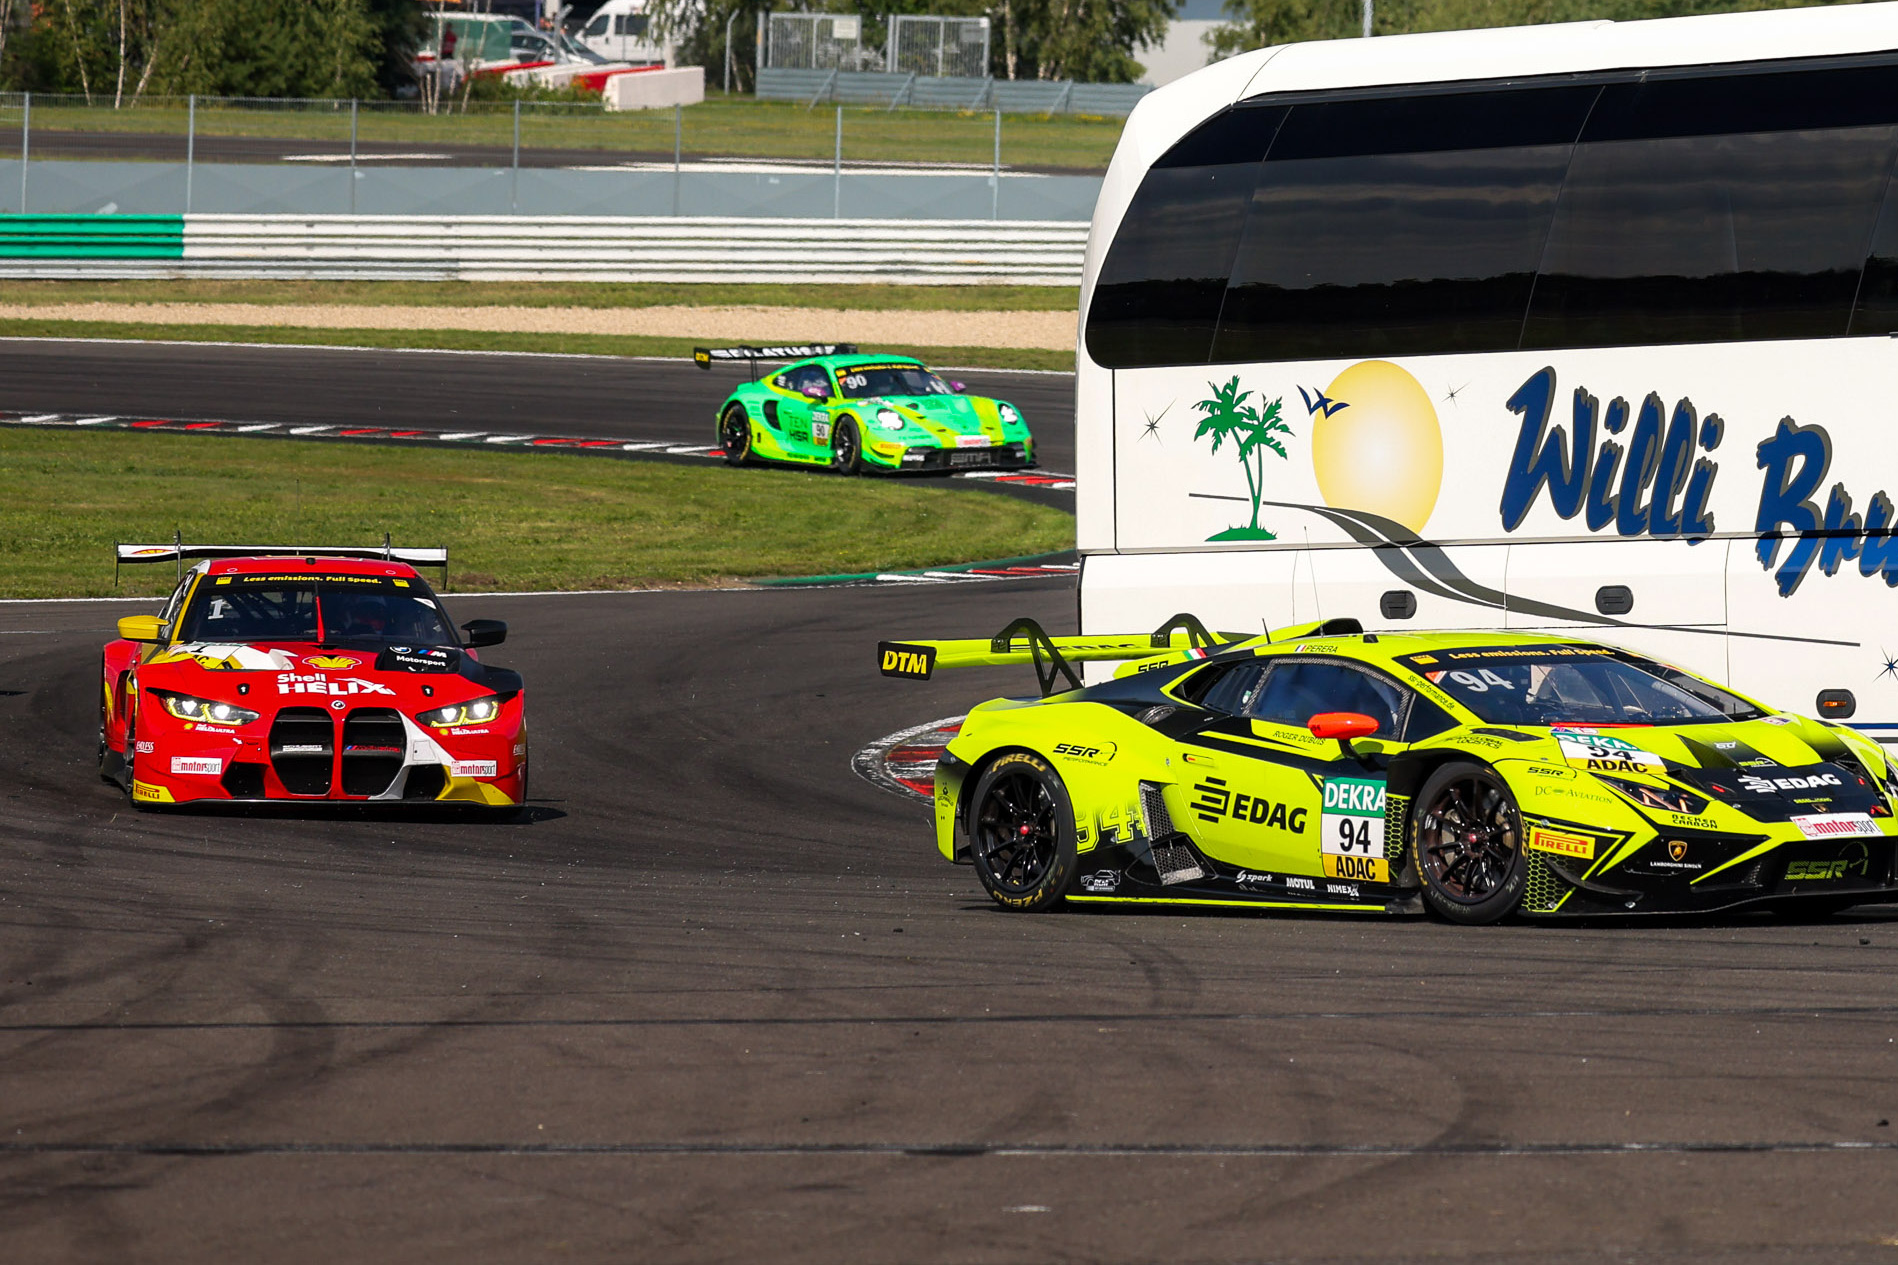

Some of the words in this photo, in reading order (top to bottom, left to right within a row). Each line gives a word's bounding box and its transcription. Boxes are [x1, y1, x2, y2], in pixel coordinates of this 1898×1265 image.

[846, 374, 868, 389] 90
[1500, 365, 1725, 547] Willi
[208, 599, 226, 620] 1
[1304, 645, 1338, 653] PERERA
[1449, 650, 1481, 660] Less
[1481, 649, 1550, 658] emissions.
[1550, 648, 1575, 656] Full
[396, 655, 446, 666] Motorsport
[882, 650, 928, 675] DTM
[277, 672, 326, 683] Shell
[1450, 669, 1515, 692] 94
[277, 677, 397, 696] HELIX
[1407, 674, 1455, 710] ssr-performance.de
[1273, 730, 1299, 743] ROGER
[1053, 743, 1100, 758] SSR
[181, 761, 220, 773] motorsport
[460, 764, 496, 775] motorsport
[992, 754, 1047, 772] PIRELLI
[1587, 759, 1648, 773] ADAC
[1527, 766, 1564, 776] SSR
[1773, 774, 1842, 790] EDAG
[1324, 782, 1386, 812] DEKRA
[1535, 785, 1552, 796] DC
[1232, 793, 1308, 834] EDAG
[1813, 819, 1881, 834] motorsport
[1339, 818, 1371, 854] 94
[1533, 831, 1588, 855] PIRELLI
[1336, 855, 1376, 881] ADAC
[1785, 860, 1848, 880] SSR
[1247, 873, 1273, 882] spark
[1286, 877, 1315, 890] MOTUL
